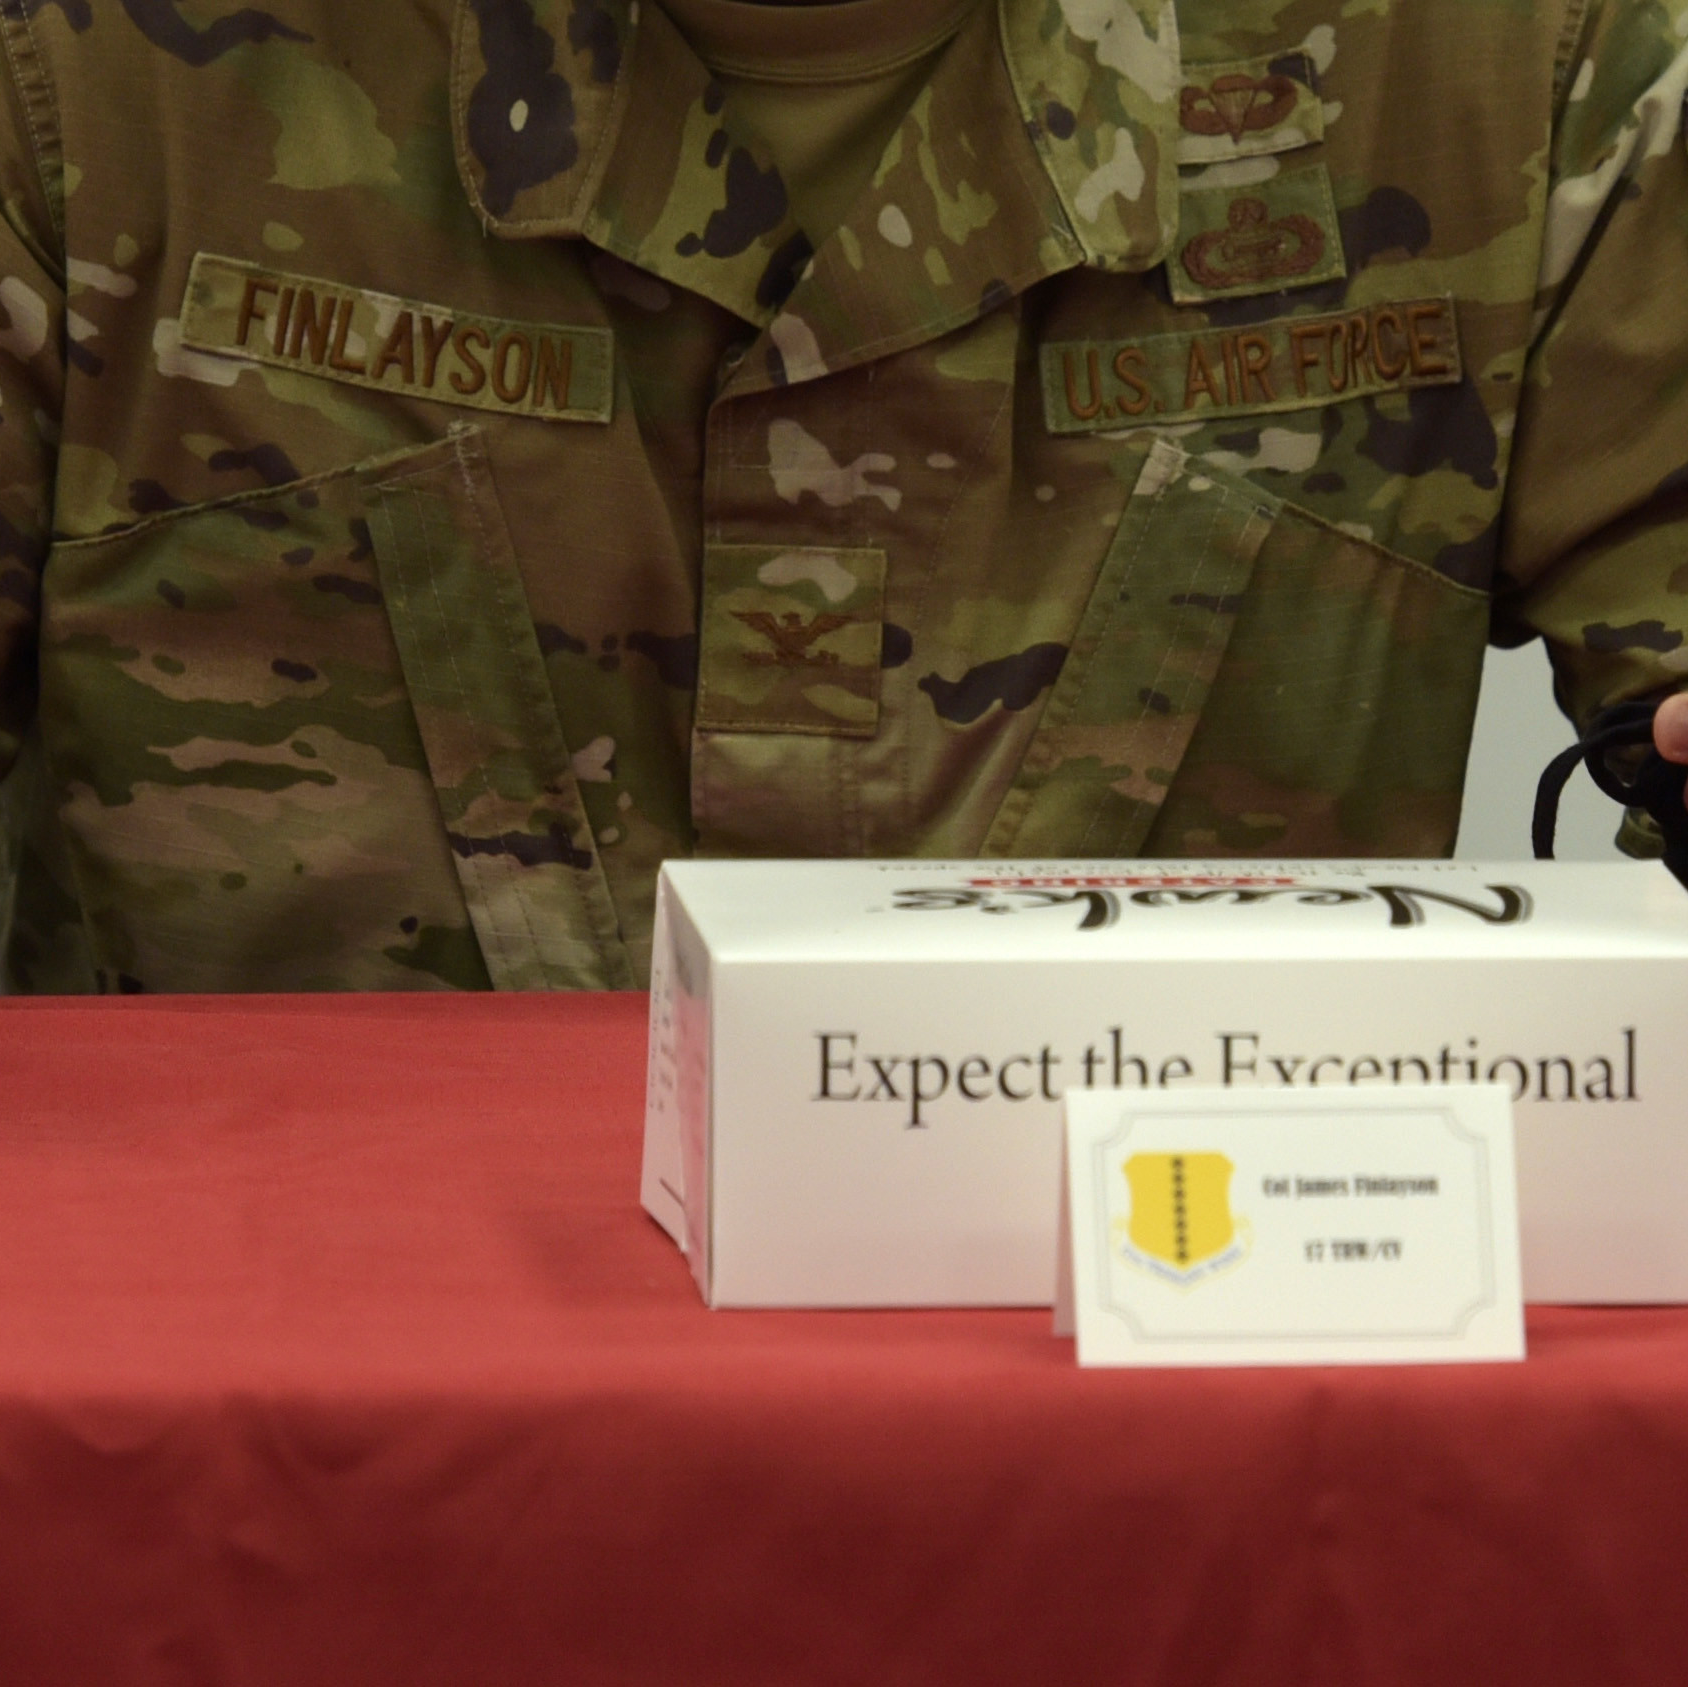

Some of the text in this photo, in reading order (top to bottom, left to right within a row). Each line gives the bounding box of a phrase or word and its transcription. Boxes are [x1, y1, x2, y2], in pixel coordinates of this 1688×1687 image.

[235, 277, 572, 410] FINLAYSON
[1062, 305, 1448, 420] U.S. AIR FORCE
[889, 882, 1535, 931] Newk's
[811, 1030, 1062, 1130] Expect
[1081, 1025, 1195, 1088] the
